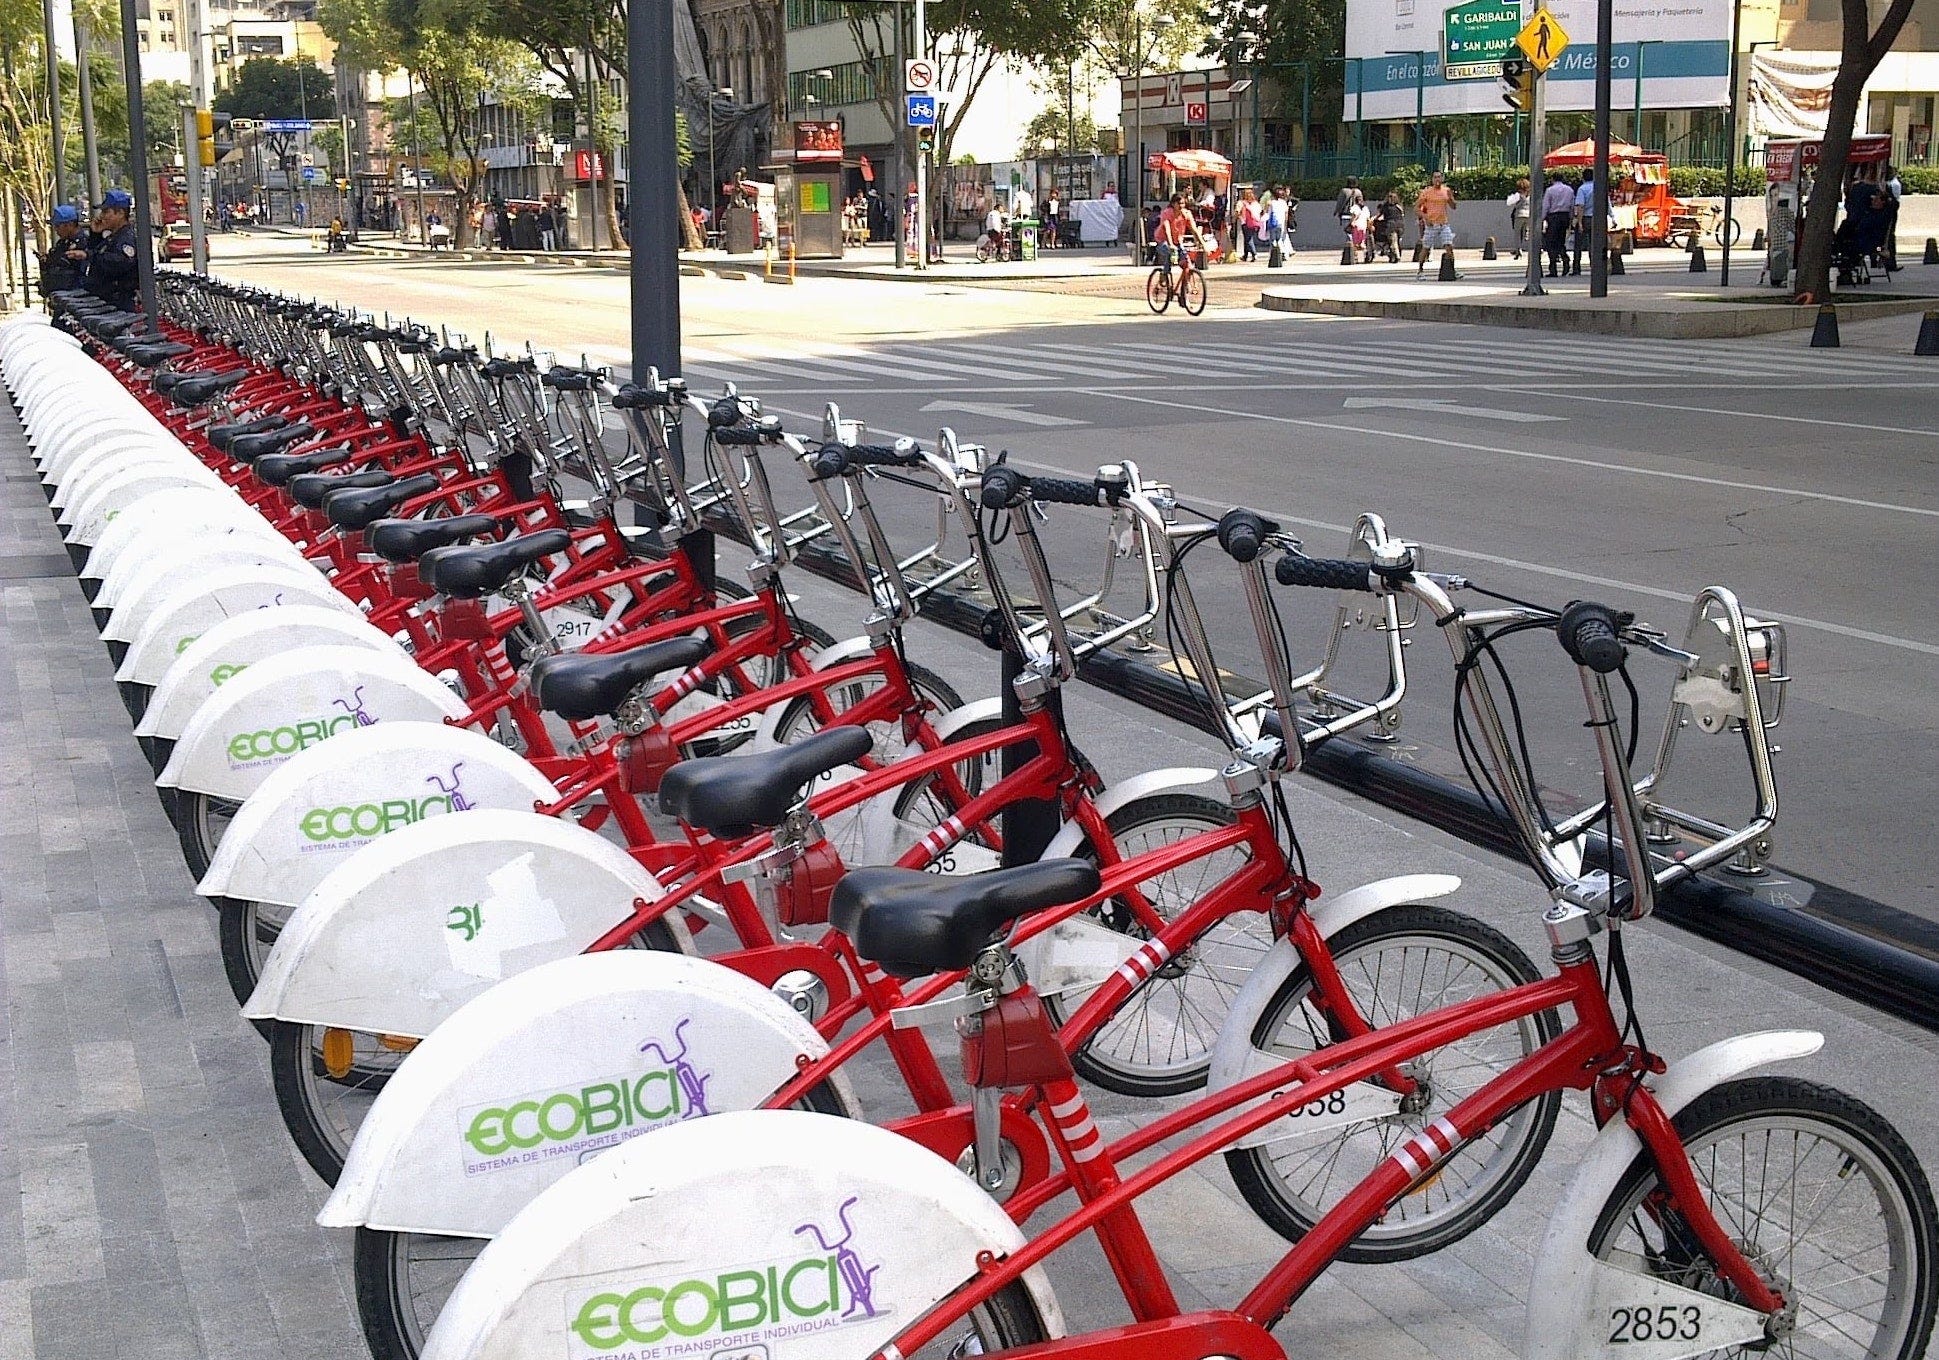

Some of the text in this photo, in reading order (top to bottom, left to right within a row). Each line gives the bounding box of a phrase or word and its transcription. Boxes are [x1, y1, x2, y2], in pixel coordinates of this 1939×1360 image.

[1463, 11, 1517, 24] GARIBALDI
[1463, 39, 1508, 51] SAN JUAN
[1386, 64, 1398, 80] En
[1399, 62, 1408, 79] el
[1564, 52, 1630, 70] Méxco
[1189, 104, 1203, 119] K
[556, 621, 591, 637] 2917
[465, 1067, 681, 1155] ECOBICI
[468, 1156, 520, 1174] SISTEMA
[522, 1151, 538, 1163] DE
[542, 1133, 618, 1158] TRANSPORTE
[571, 1255, 840, 1349] ECOBICI
[641, 1347, 660, 1360] DE
[665, 1330, 760, 1356] TRANSPORTE
[764, 1317, 839, 1339] INDIVIDUAL
[1609, 1306, 1701, 1343] 2853
